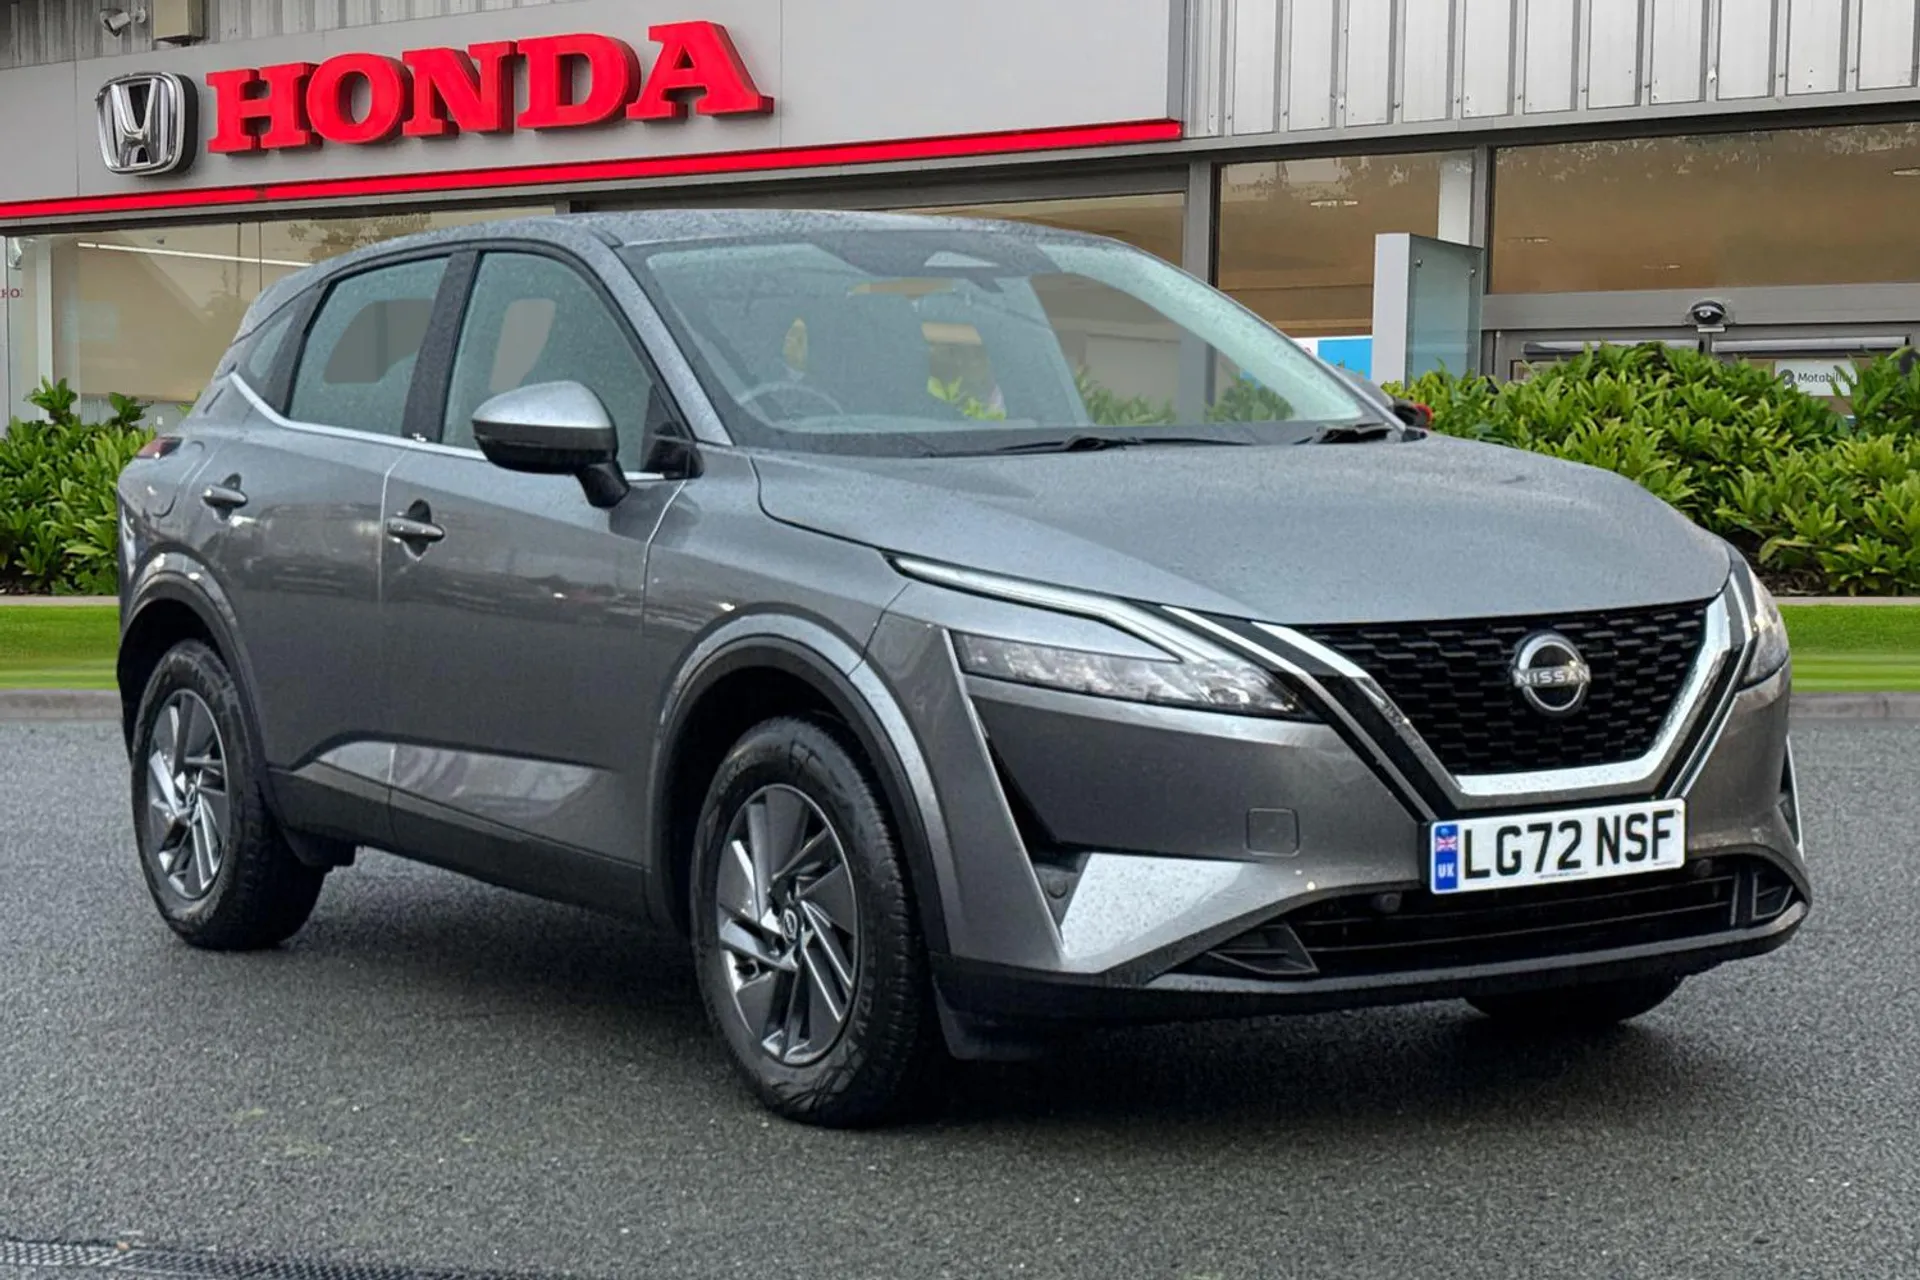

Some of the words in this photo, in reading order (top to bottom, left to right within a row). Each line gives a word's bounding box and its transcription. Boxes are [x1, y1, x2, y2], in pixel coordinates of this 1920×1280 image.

[206, 20, 774, 154] HONDA
[1513, 665, 1591, 688] NISSAN
[1464, 819, 1582, 880] LG72
[1596, 809, 1675, 866] NSF
[1438, 862, 1455, 878] UK
